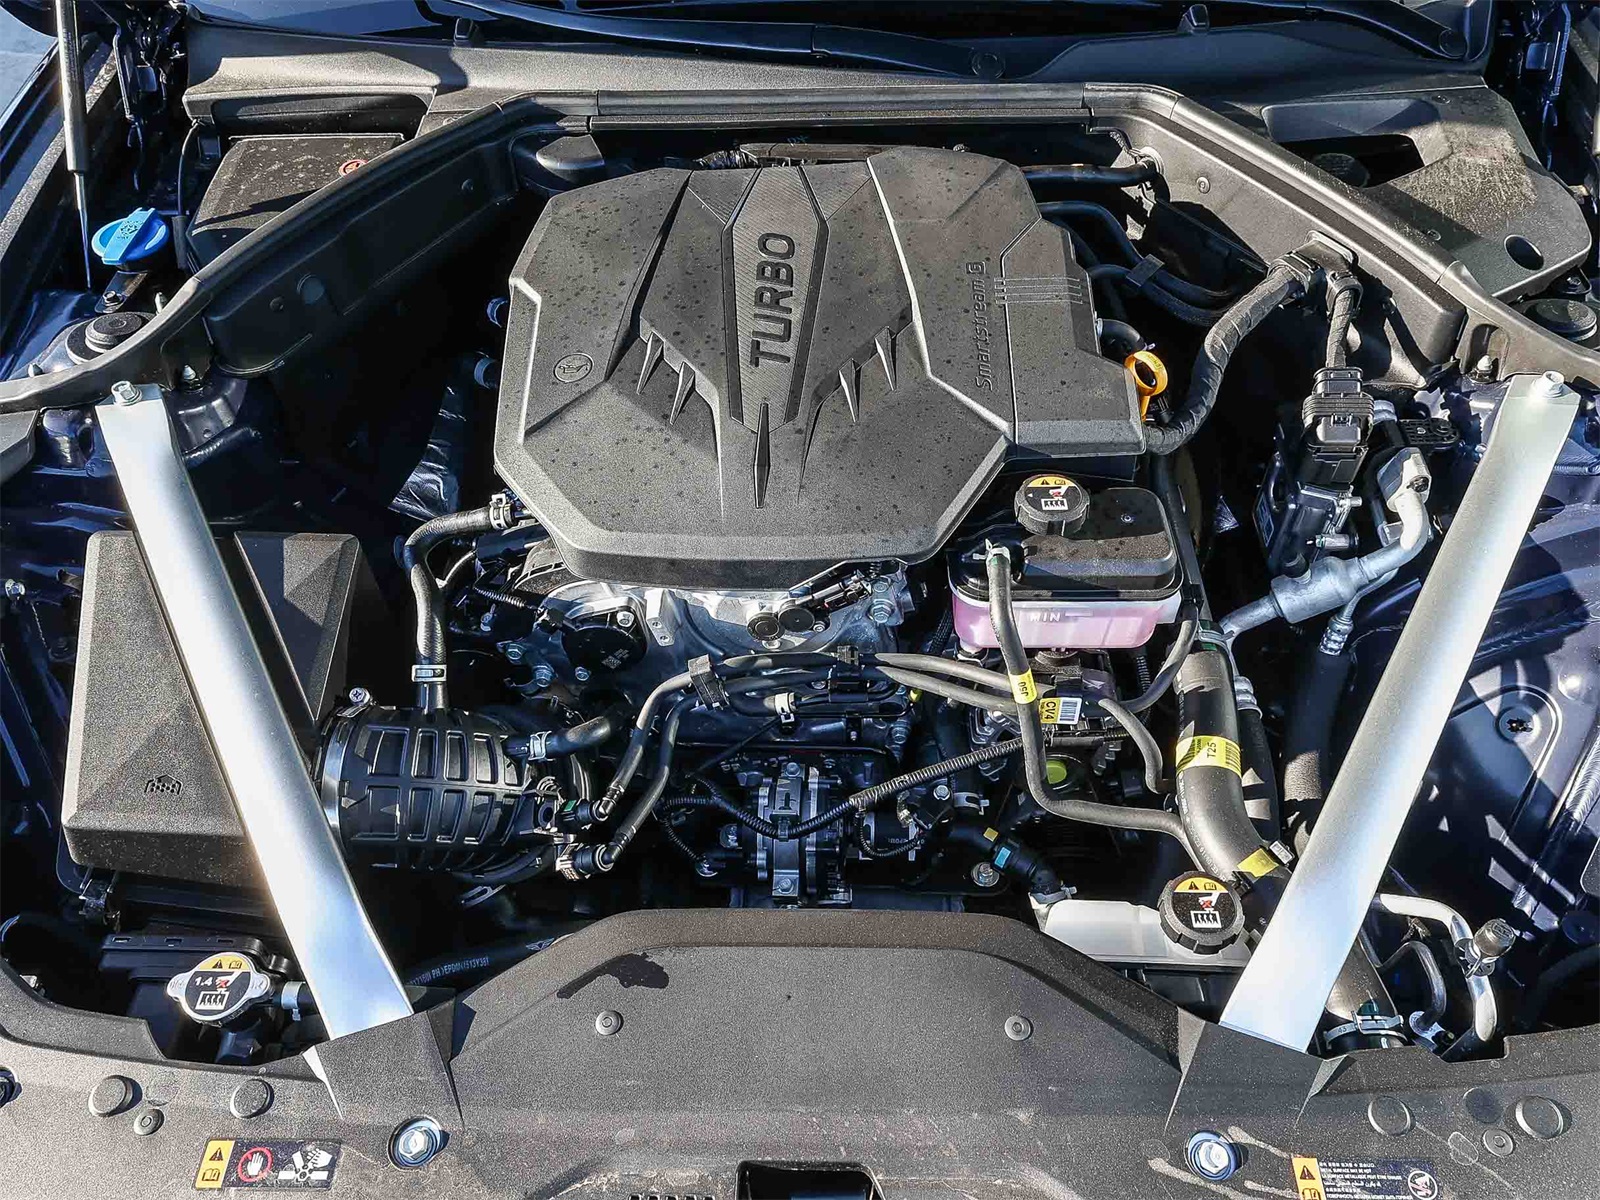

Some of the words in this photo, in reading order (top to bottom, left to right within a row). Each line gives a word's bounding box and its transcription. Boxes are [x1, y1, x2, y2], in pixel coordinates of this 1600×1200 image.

[966, 261, 986, 275] G
[750, 232, 795, 368] TURBO
[971, 279, 993, 391] Smartstream
[1029, 611, 1061, 622] MIN
[1044, 701, 1057, 720] CV4
[1206, 741, 1217, 759] T25
[195, 976, 214, 987] 1.4
